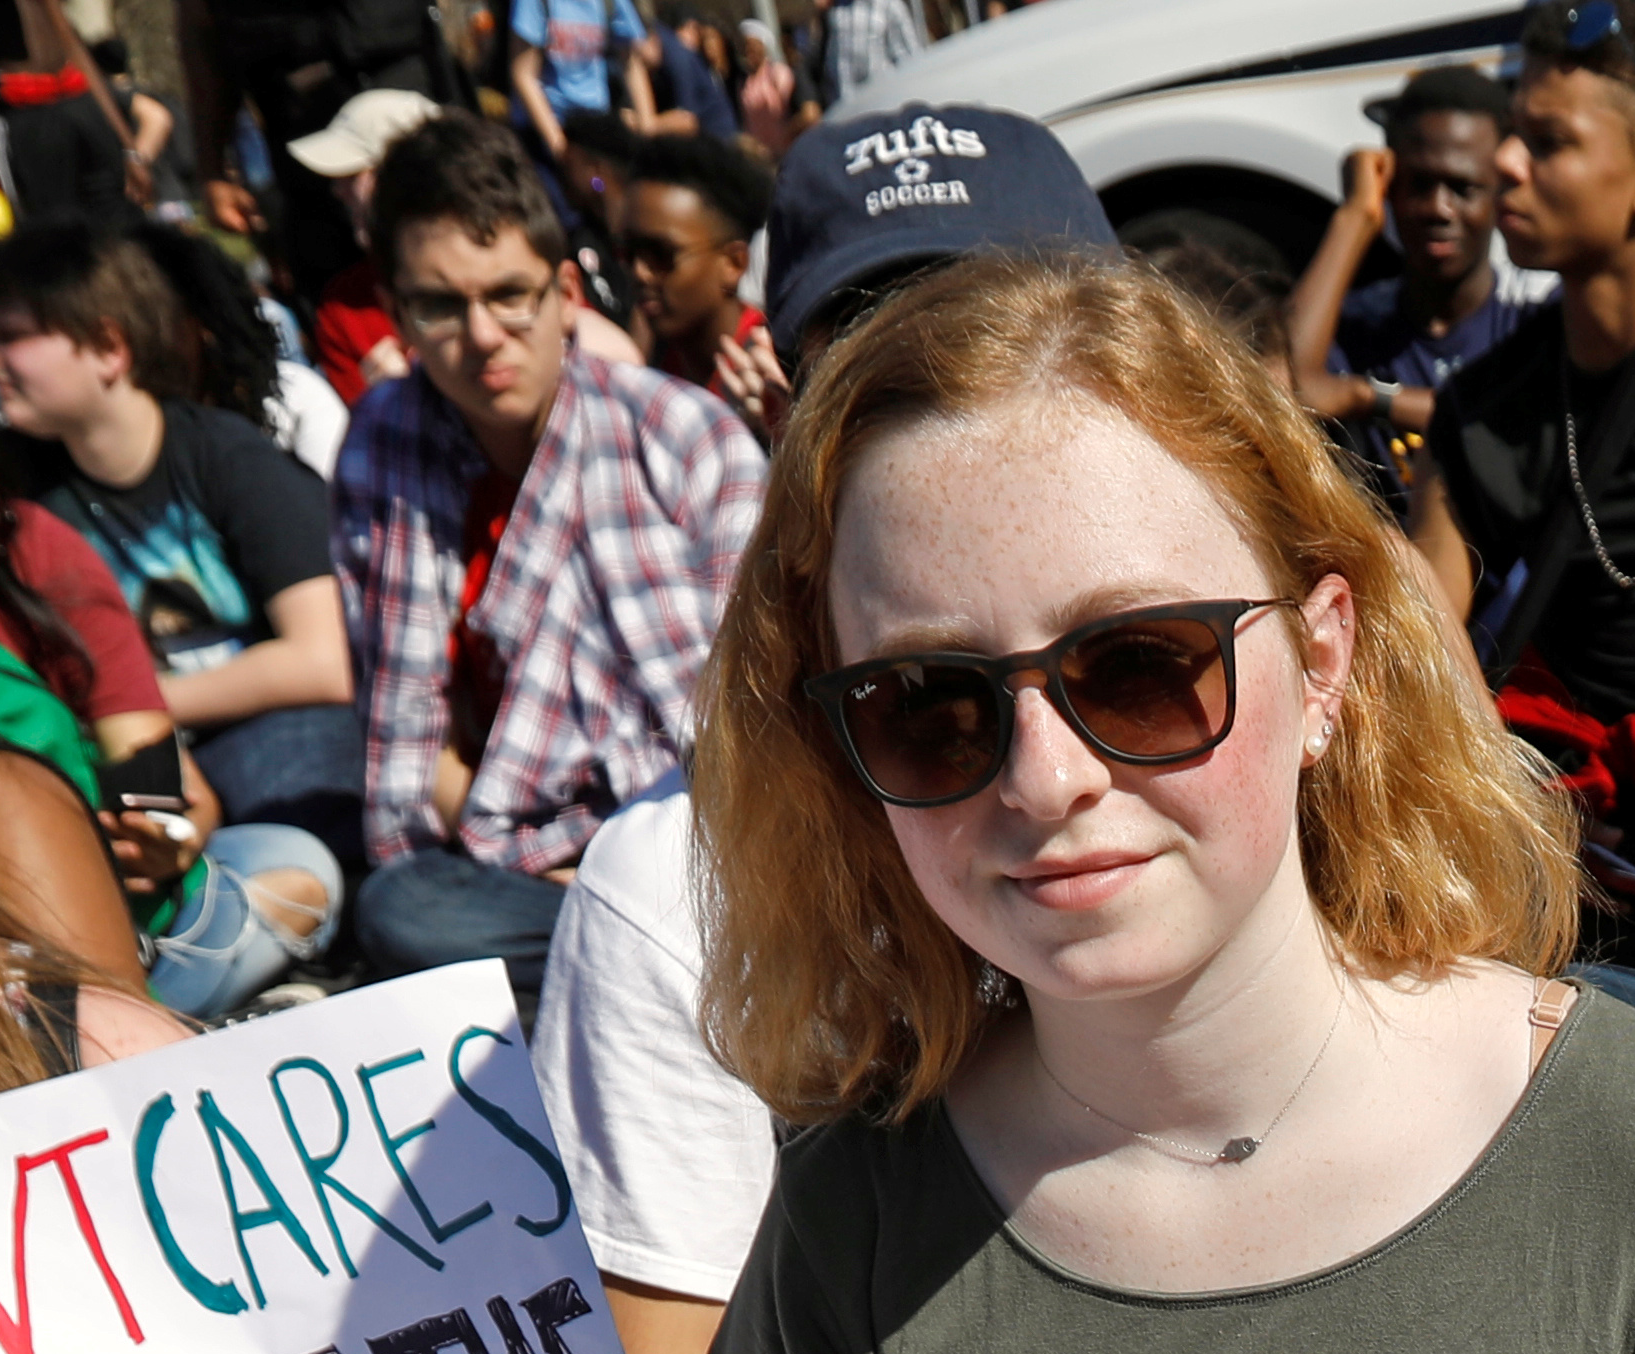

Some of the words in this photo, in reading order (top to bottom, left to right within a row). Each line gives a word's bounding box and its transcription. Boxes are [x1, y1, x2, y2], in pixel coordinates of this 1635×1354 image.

[845, 116, 986, 174] Tufts
[865, 180, 970, 216] SOCCER
[134, 1025, 575, 1315] CARES
